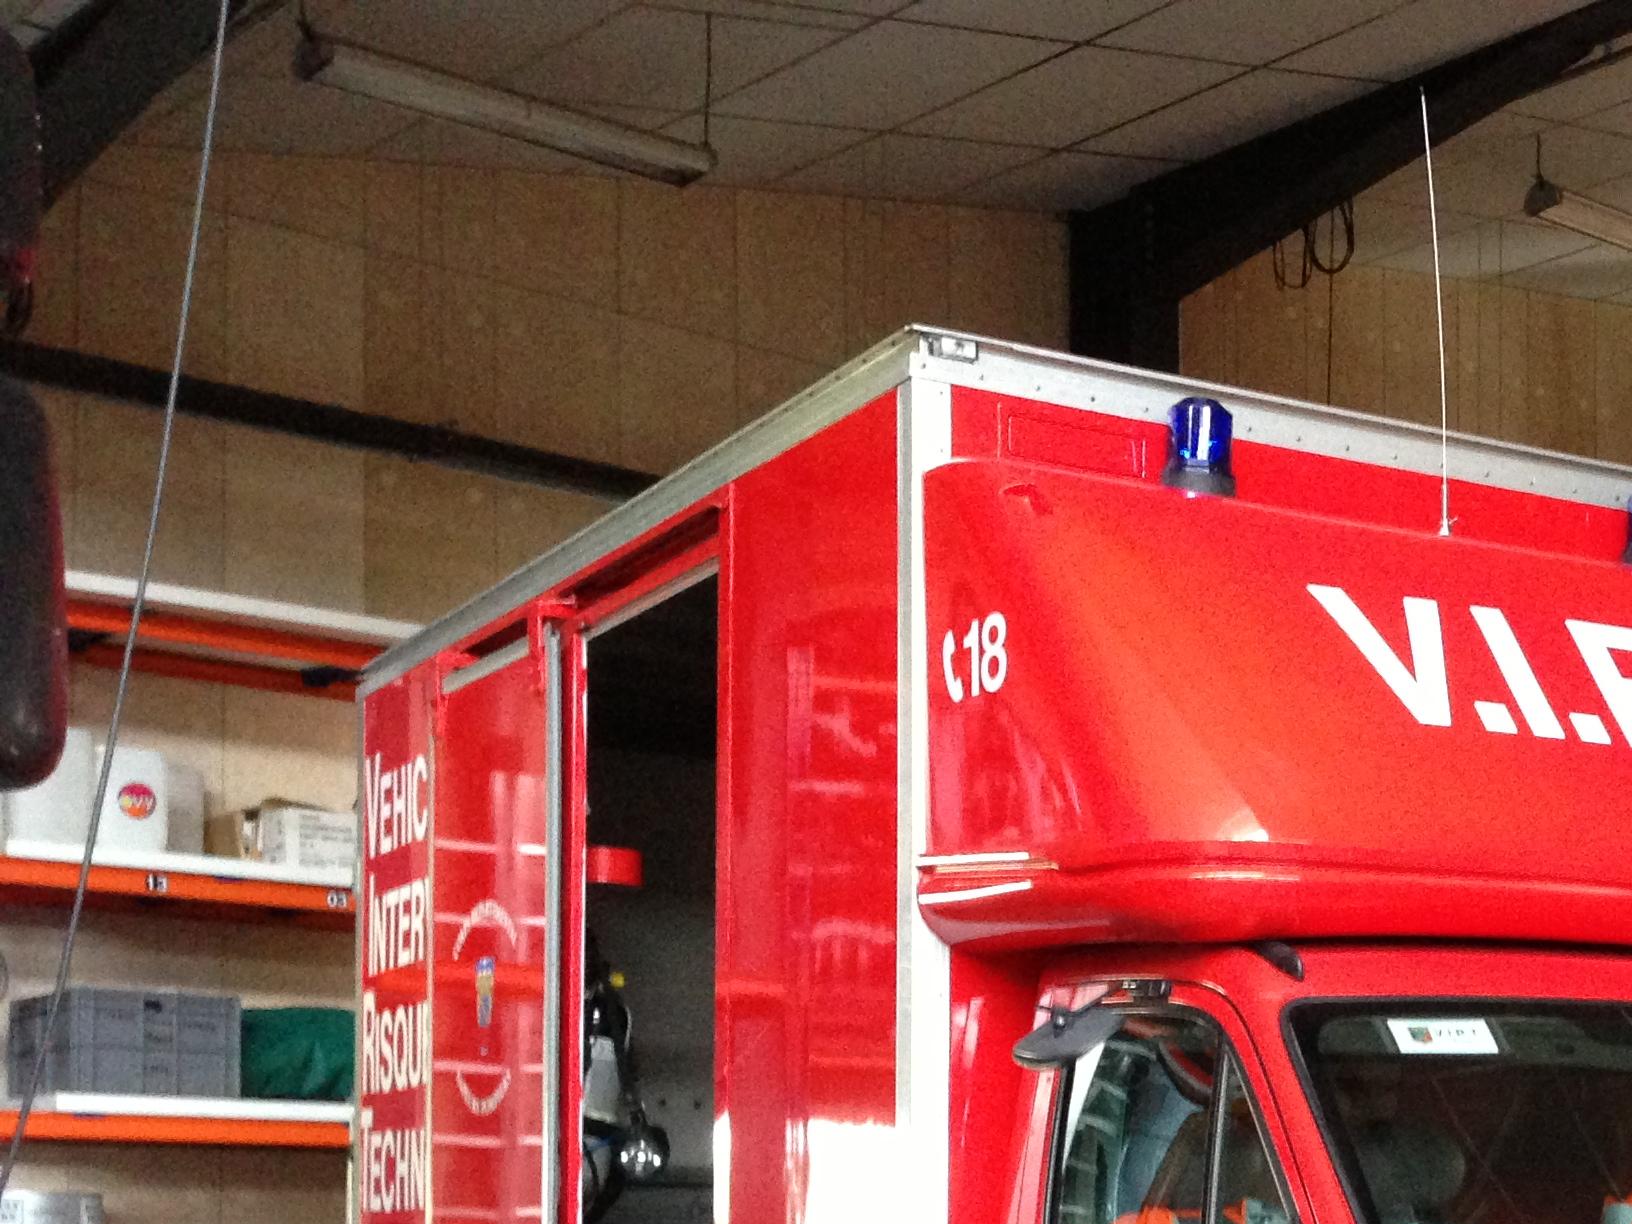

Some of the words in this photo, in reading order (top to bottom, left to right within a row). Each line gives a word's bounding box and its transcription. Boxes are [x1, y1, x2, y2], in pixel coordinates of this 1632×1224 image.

[963, 611, 1007, 697] 18
[365, 752, 428, 859] VEHIC
[361, 1107, 425, 1213] TECHN
